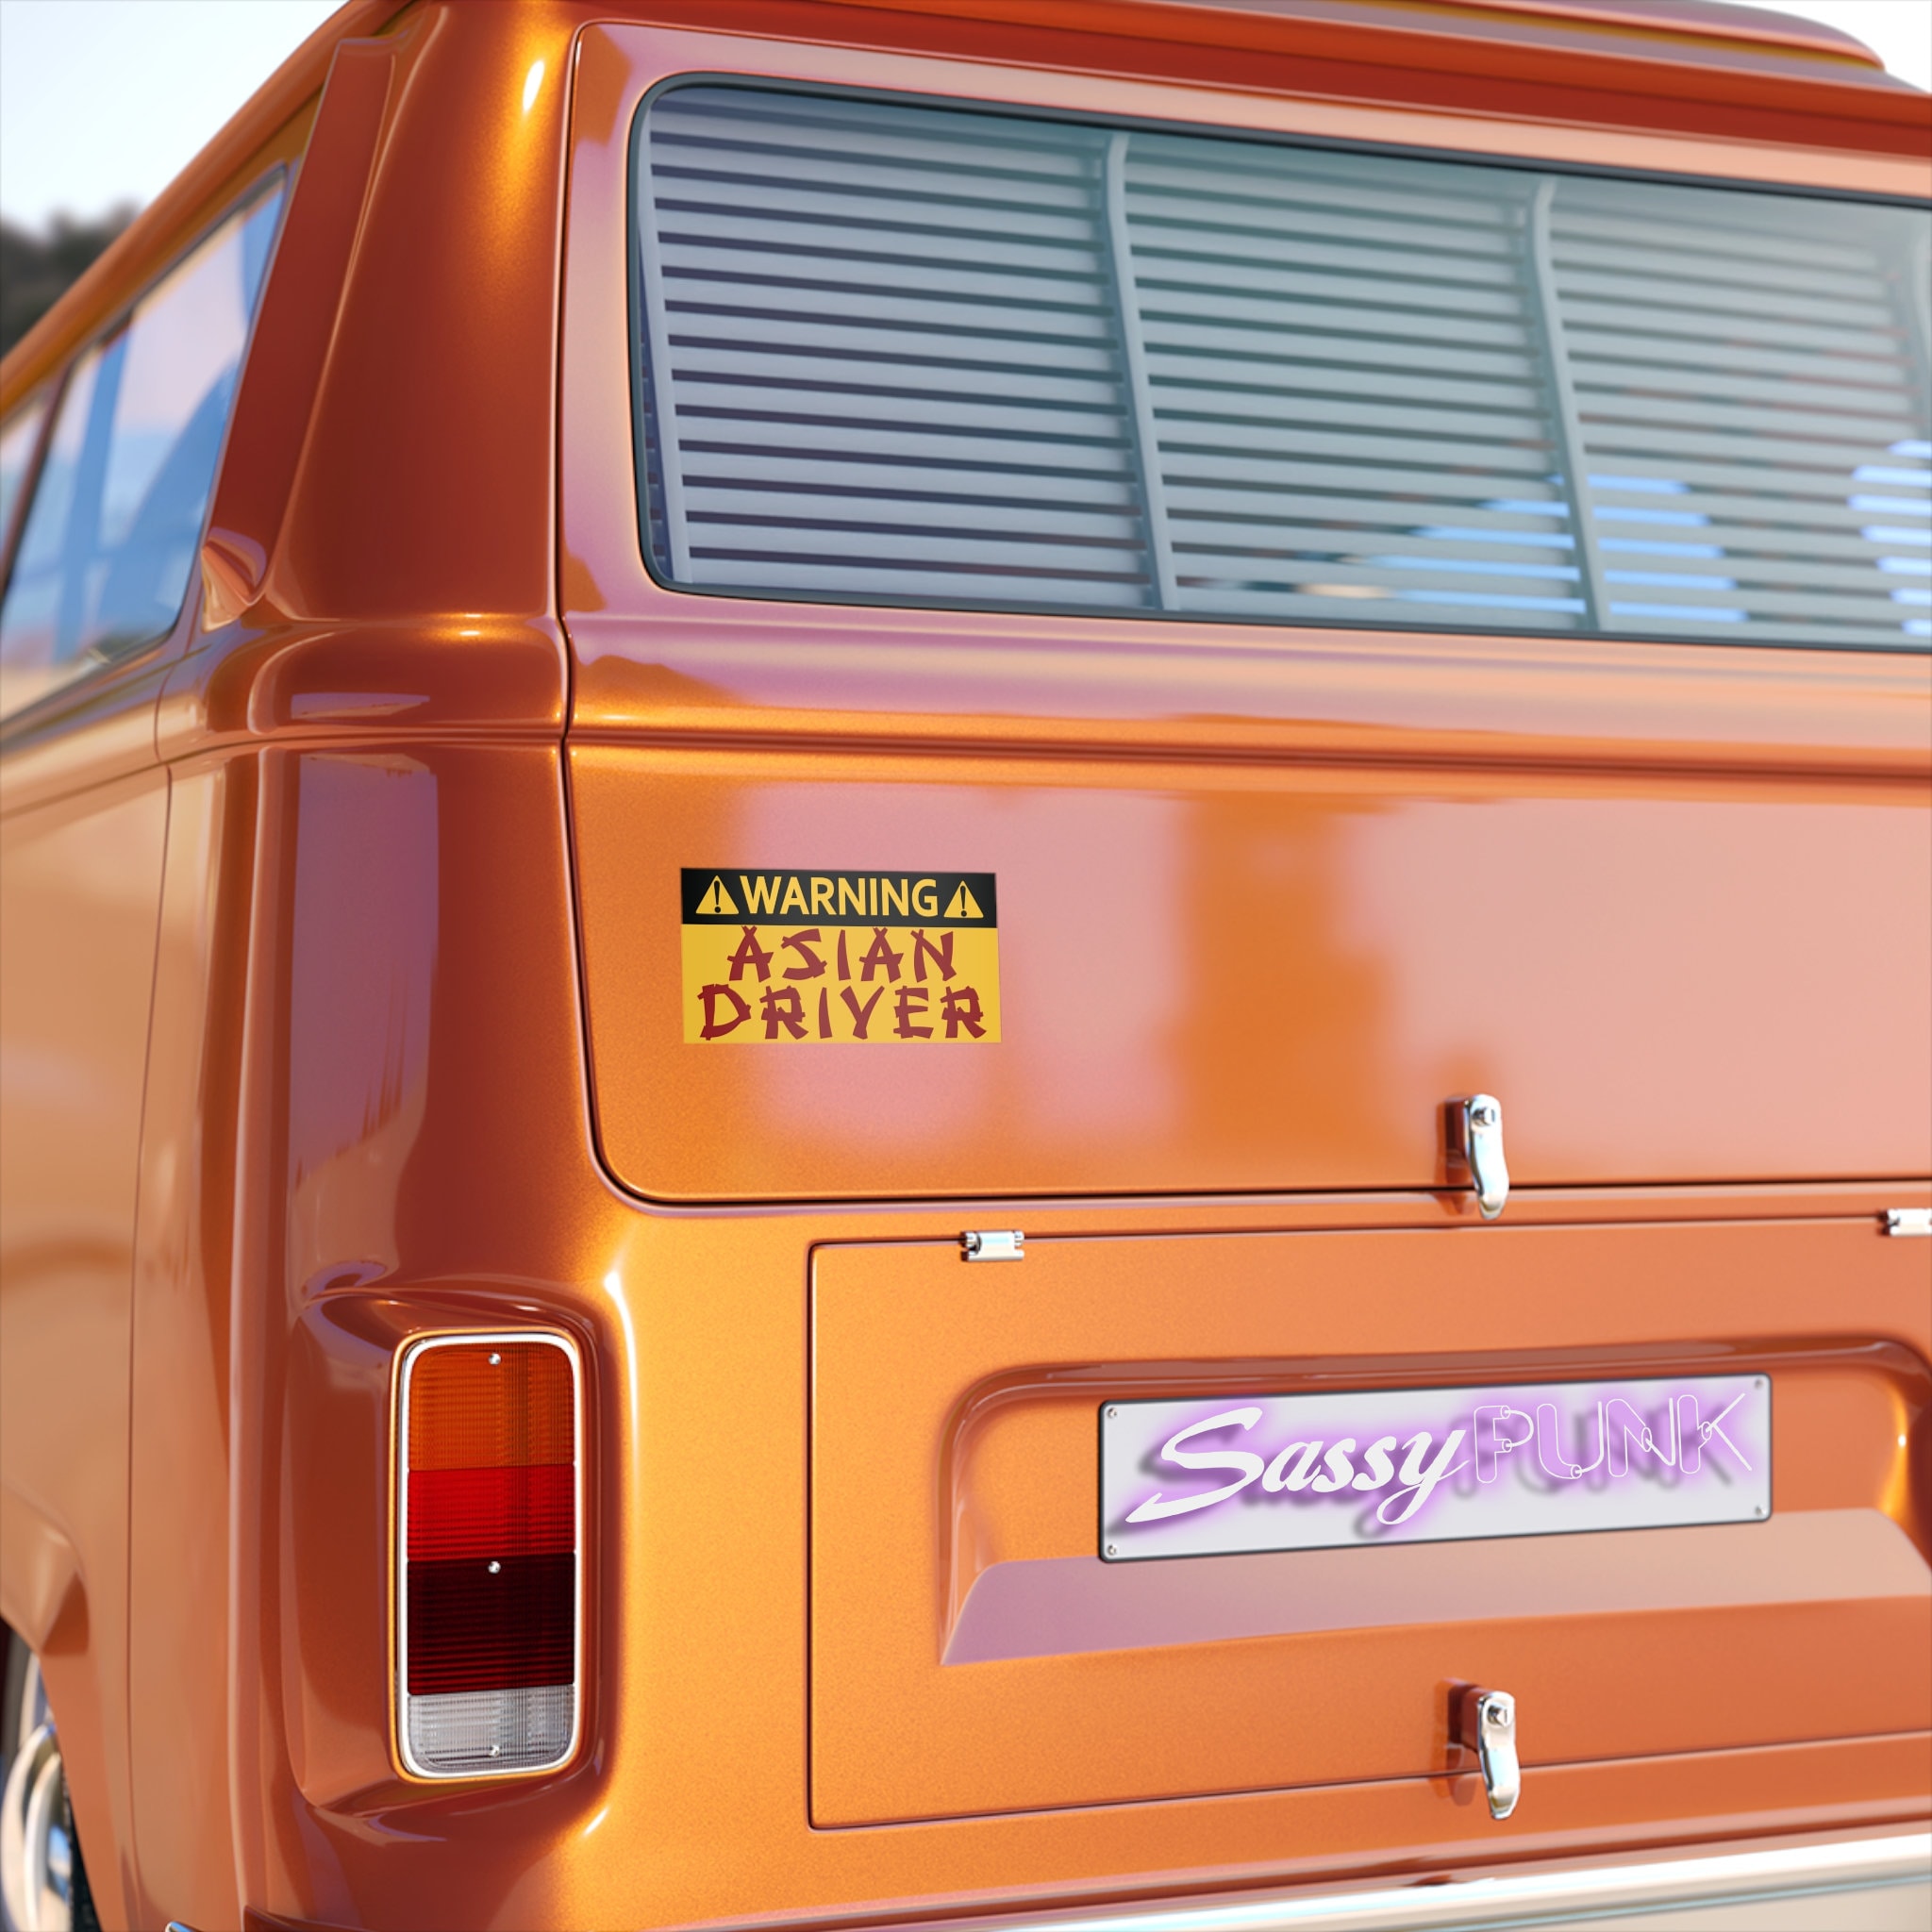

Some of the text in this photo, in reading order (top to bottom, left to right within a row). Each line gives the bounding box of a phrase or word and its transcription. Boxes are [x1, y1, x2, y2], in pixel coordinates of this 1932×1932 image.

[740, 875, 939, 918] WARNING
[727, 925, 957, 983] ASIAN
[697, 983, 987, 1041] DRIVER
